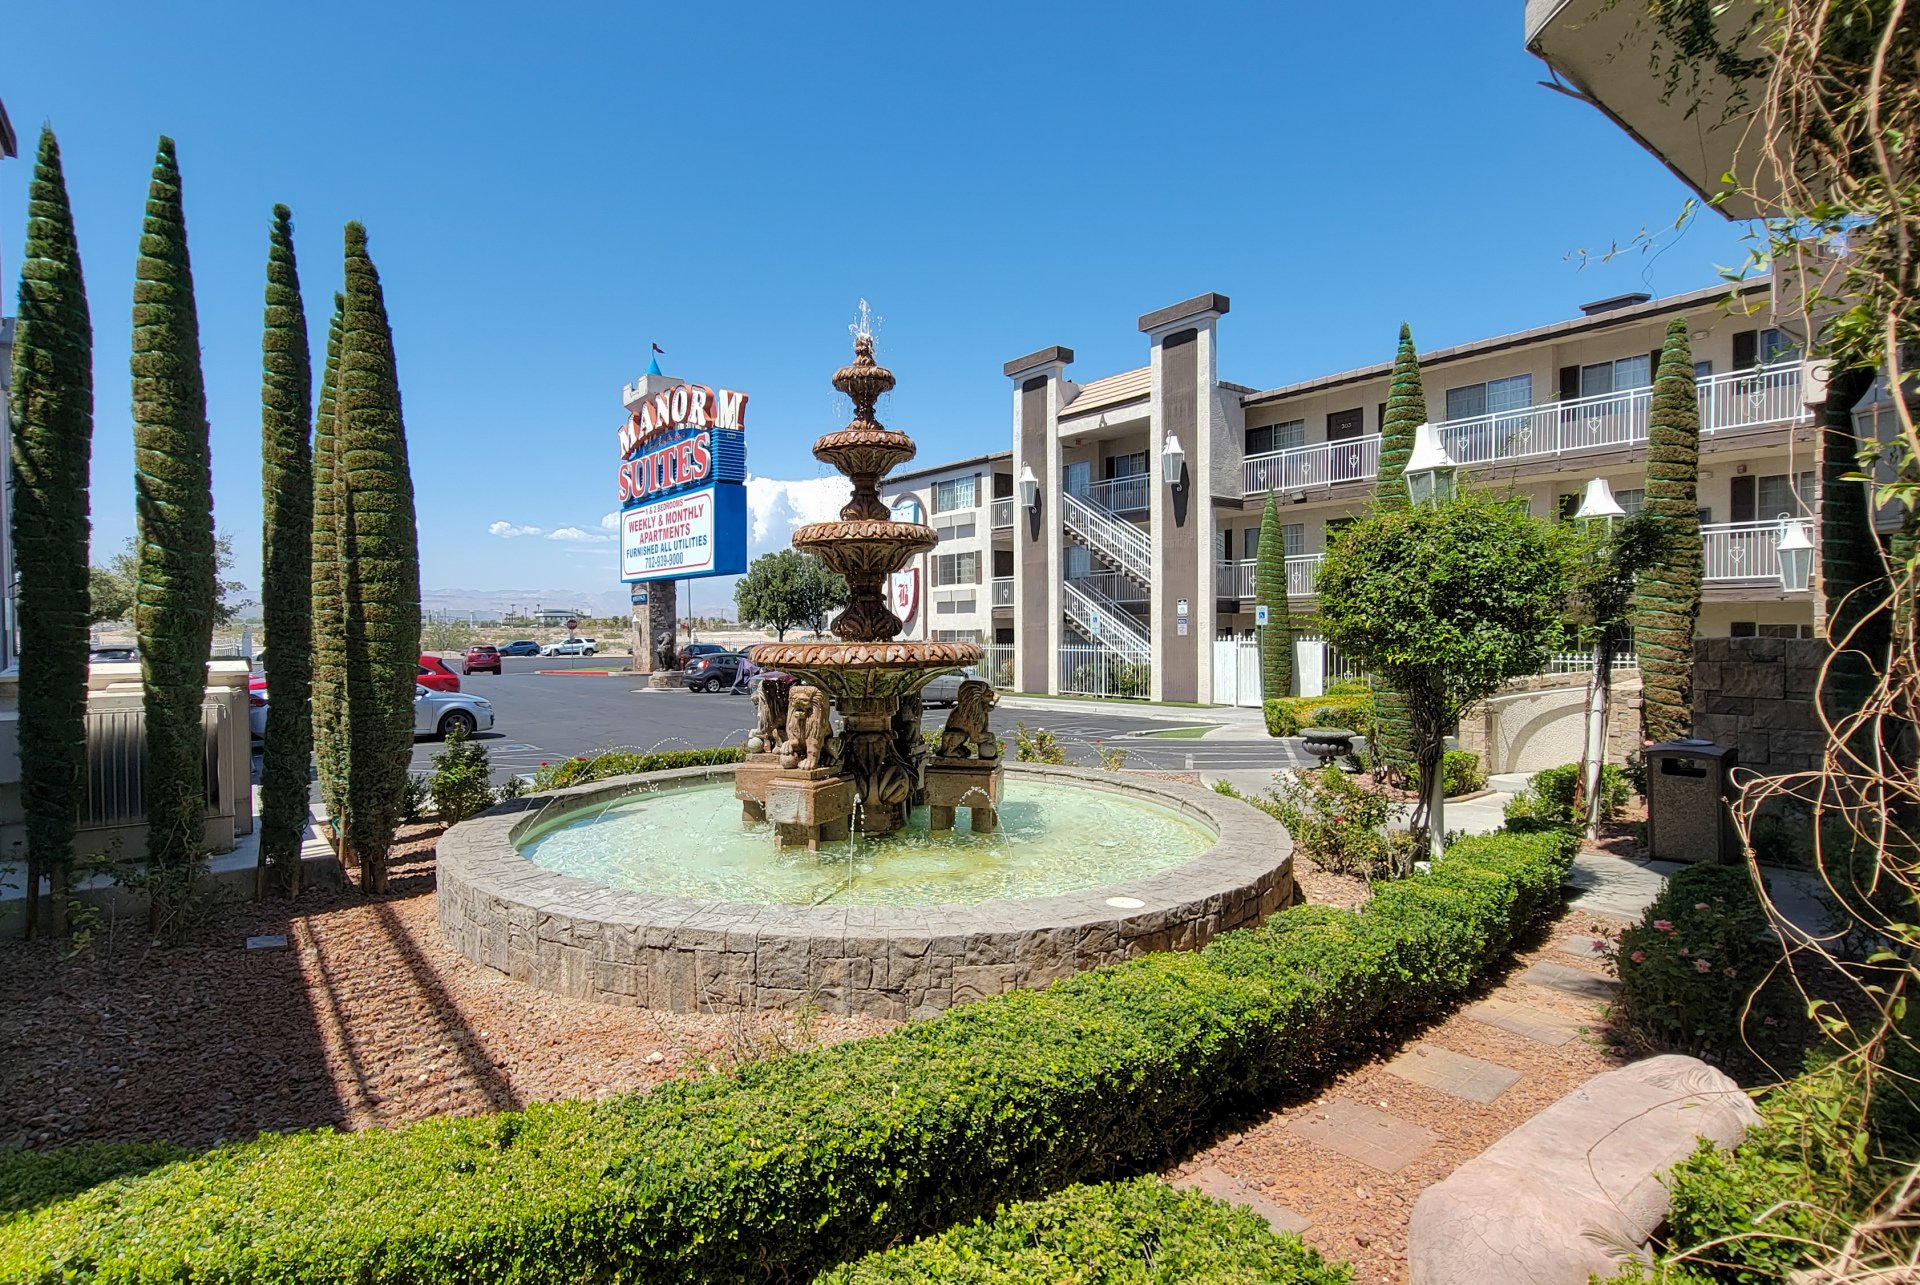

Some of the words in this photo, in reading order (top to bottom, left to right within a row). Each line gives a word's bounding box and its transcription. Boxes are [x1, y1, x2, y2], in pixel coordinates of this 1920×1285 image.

[618, 385, 708, 459] MANOR
[1098, 413, 1107, 428] A
[618, 432, 711, 502] SUITES
[657, 498, 684, 512] BEDROOMS
[628, 516, 657, 533] WEEKLY
[658, 514, 664, 526] &
[665, 504, 704, 524] MONTHLY
[639, 522, 691, 545] APARTMENTS
[626, 543, 659, 559] FURNISHED
[660, 540, 672, 553] ALL
[673, 534, 708, 551] UTILITIES
